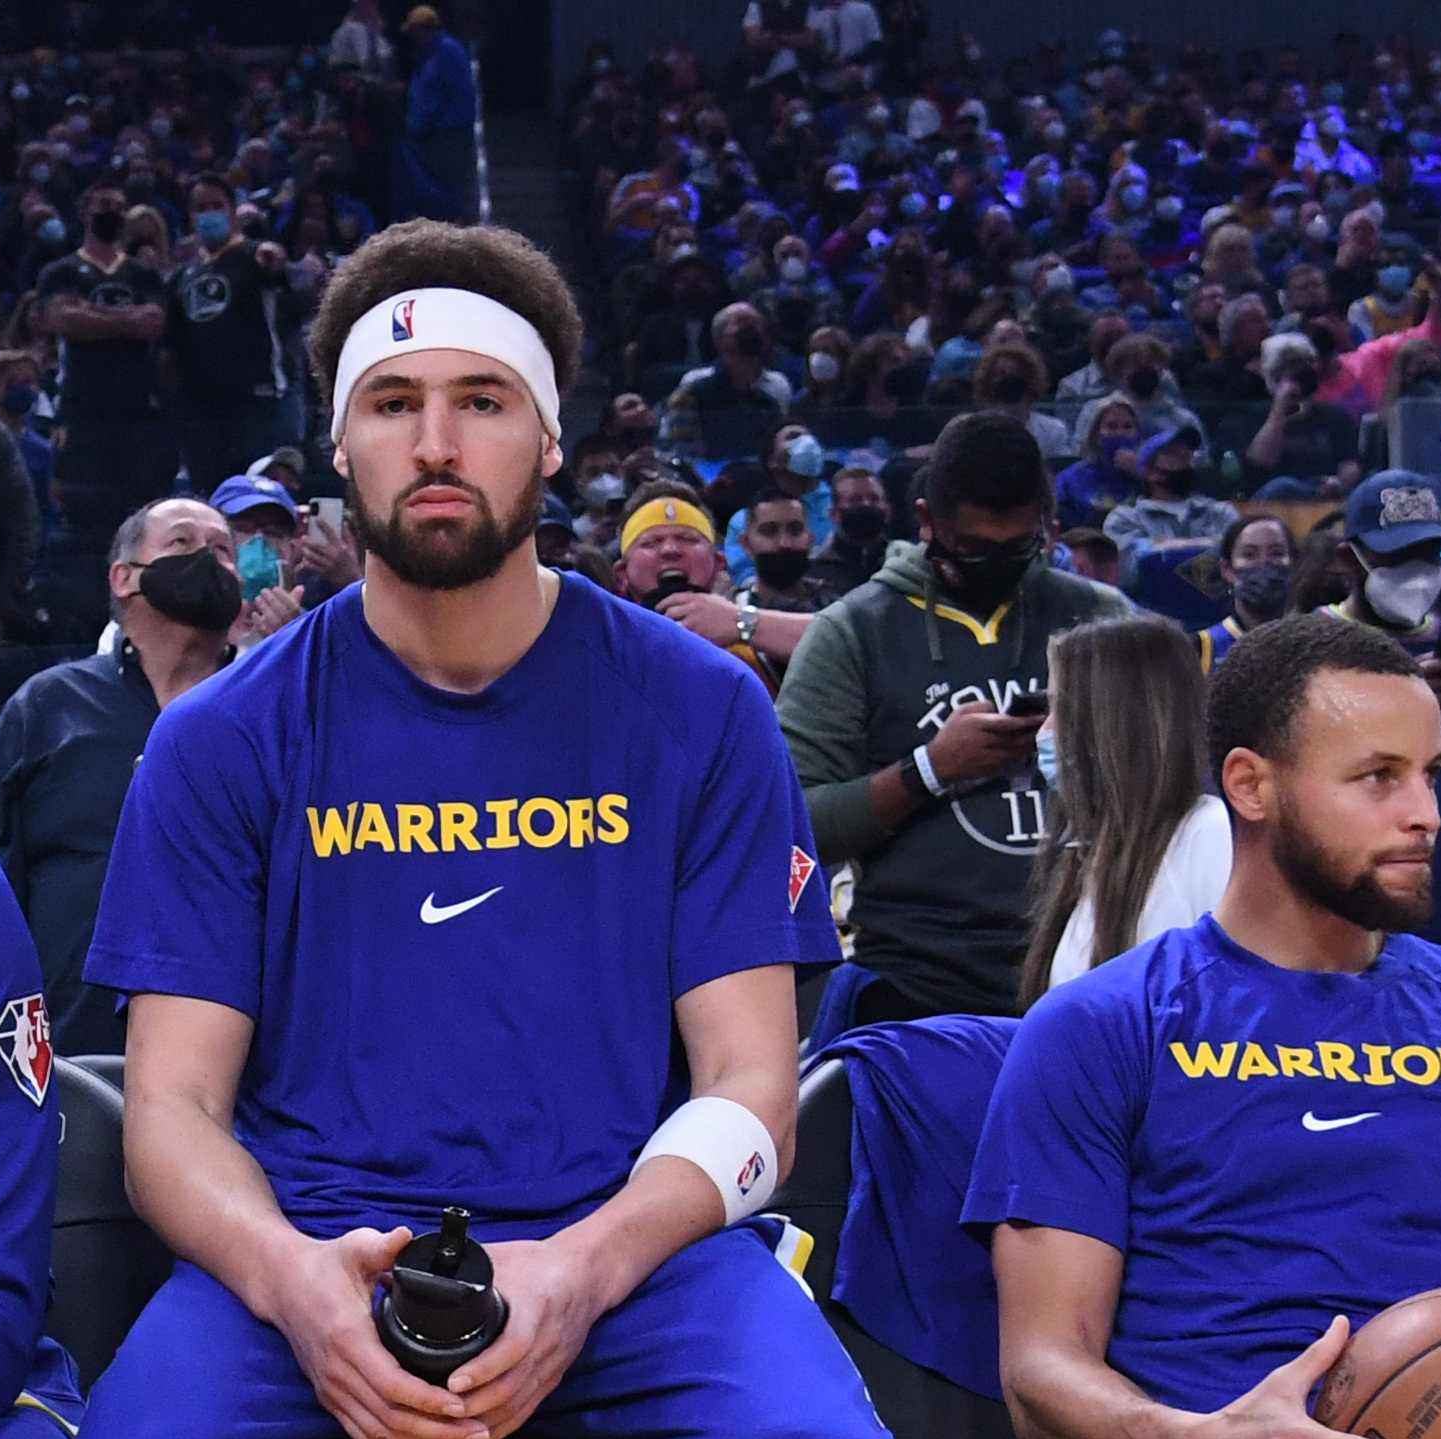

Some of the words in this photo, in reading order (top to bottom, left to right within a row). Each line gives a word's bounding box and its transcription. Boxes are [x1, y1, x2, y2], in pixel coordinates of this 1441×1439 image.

[925, 682, 950, 704] The
[306, 794, 629, 858] WARRIORS
[1001, 790, 1051, 841] 11
